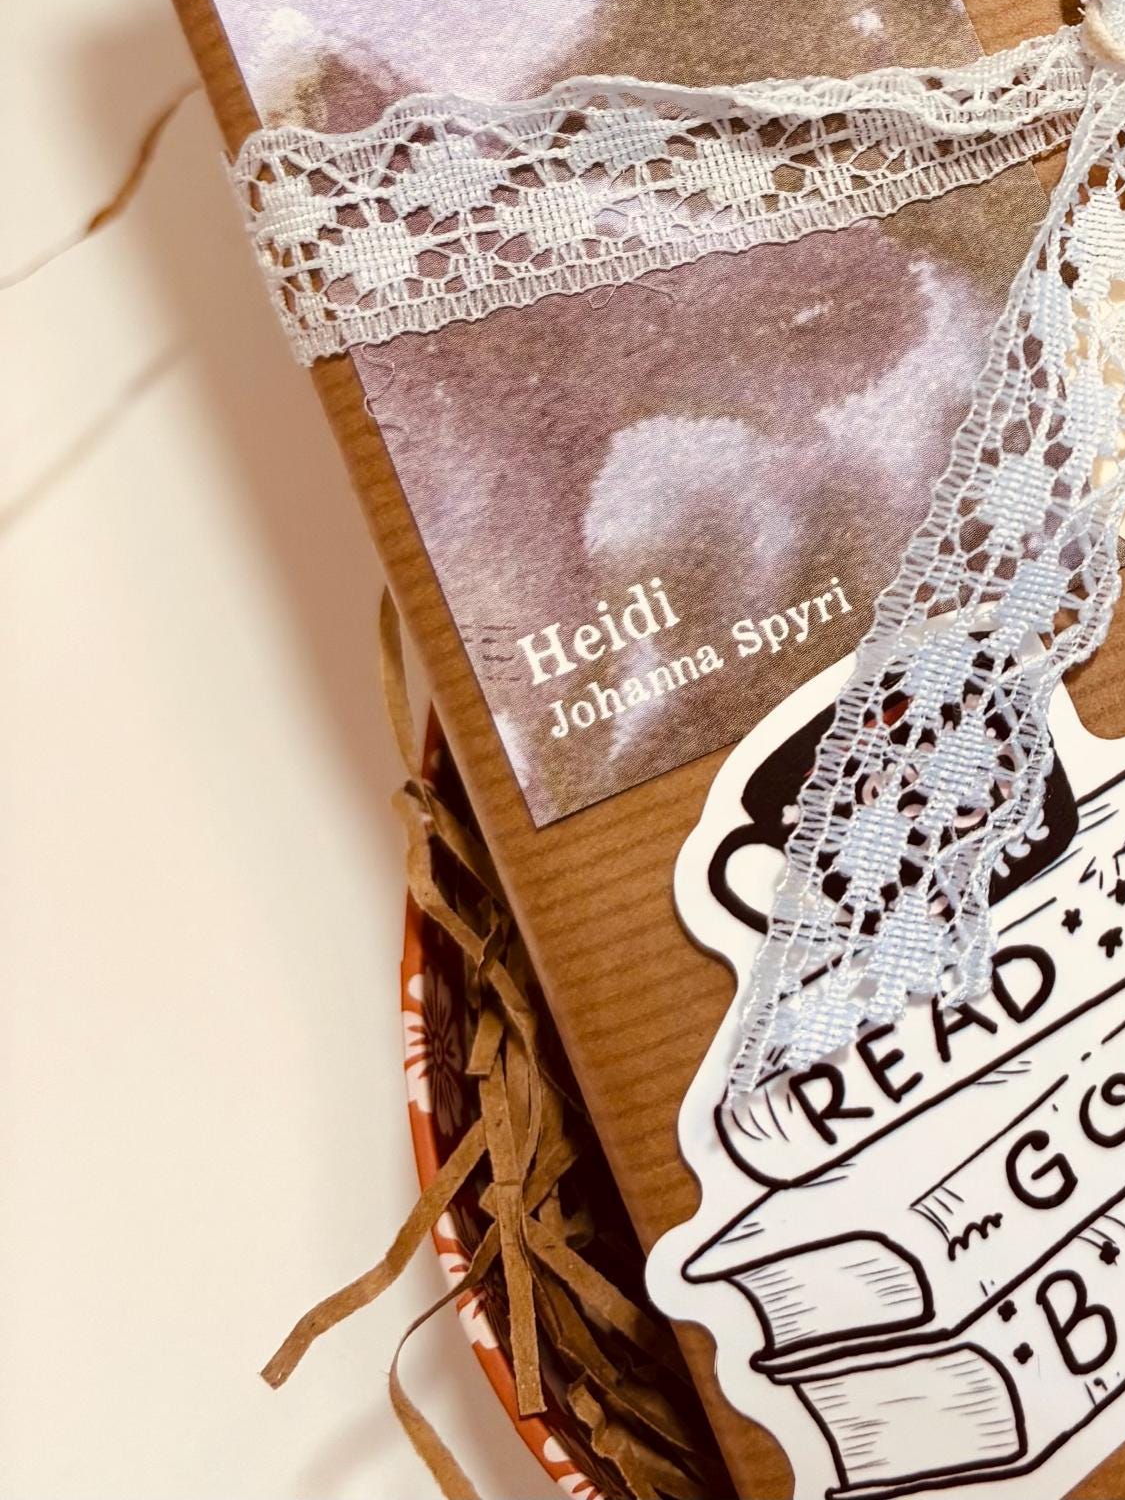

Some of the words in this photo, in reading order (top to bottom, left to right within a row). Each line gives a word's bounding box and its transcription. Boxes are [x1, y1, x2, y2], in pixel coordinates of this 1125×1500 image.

[516, 577, 681, 687] Heidi
[549, 645, 724, 739] Johanna
[732, 577, 854, 659] Spyri
[788, 943, 1056, 1146] READ
